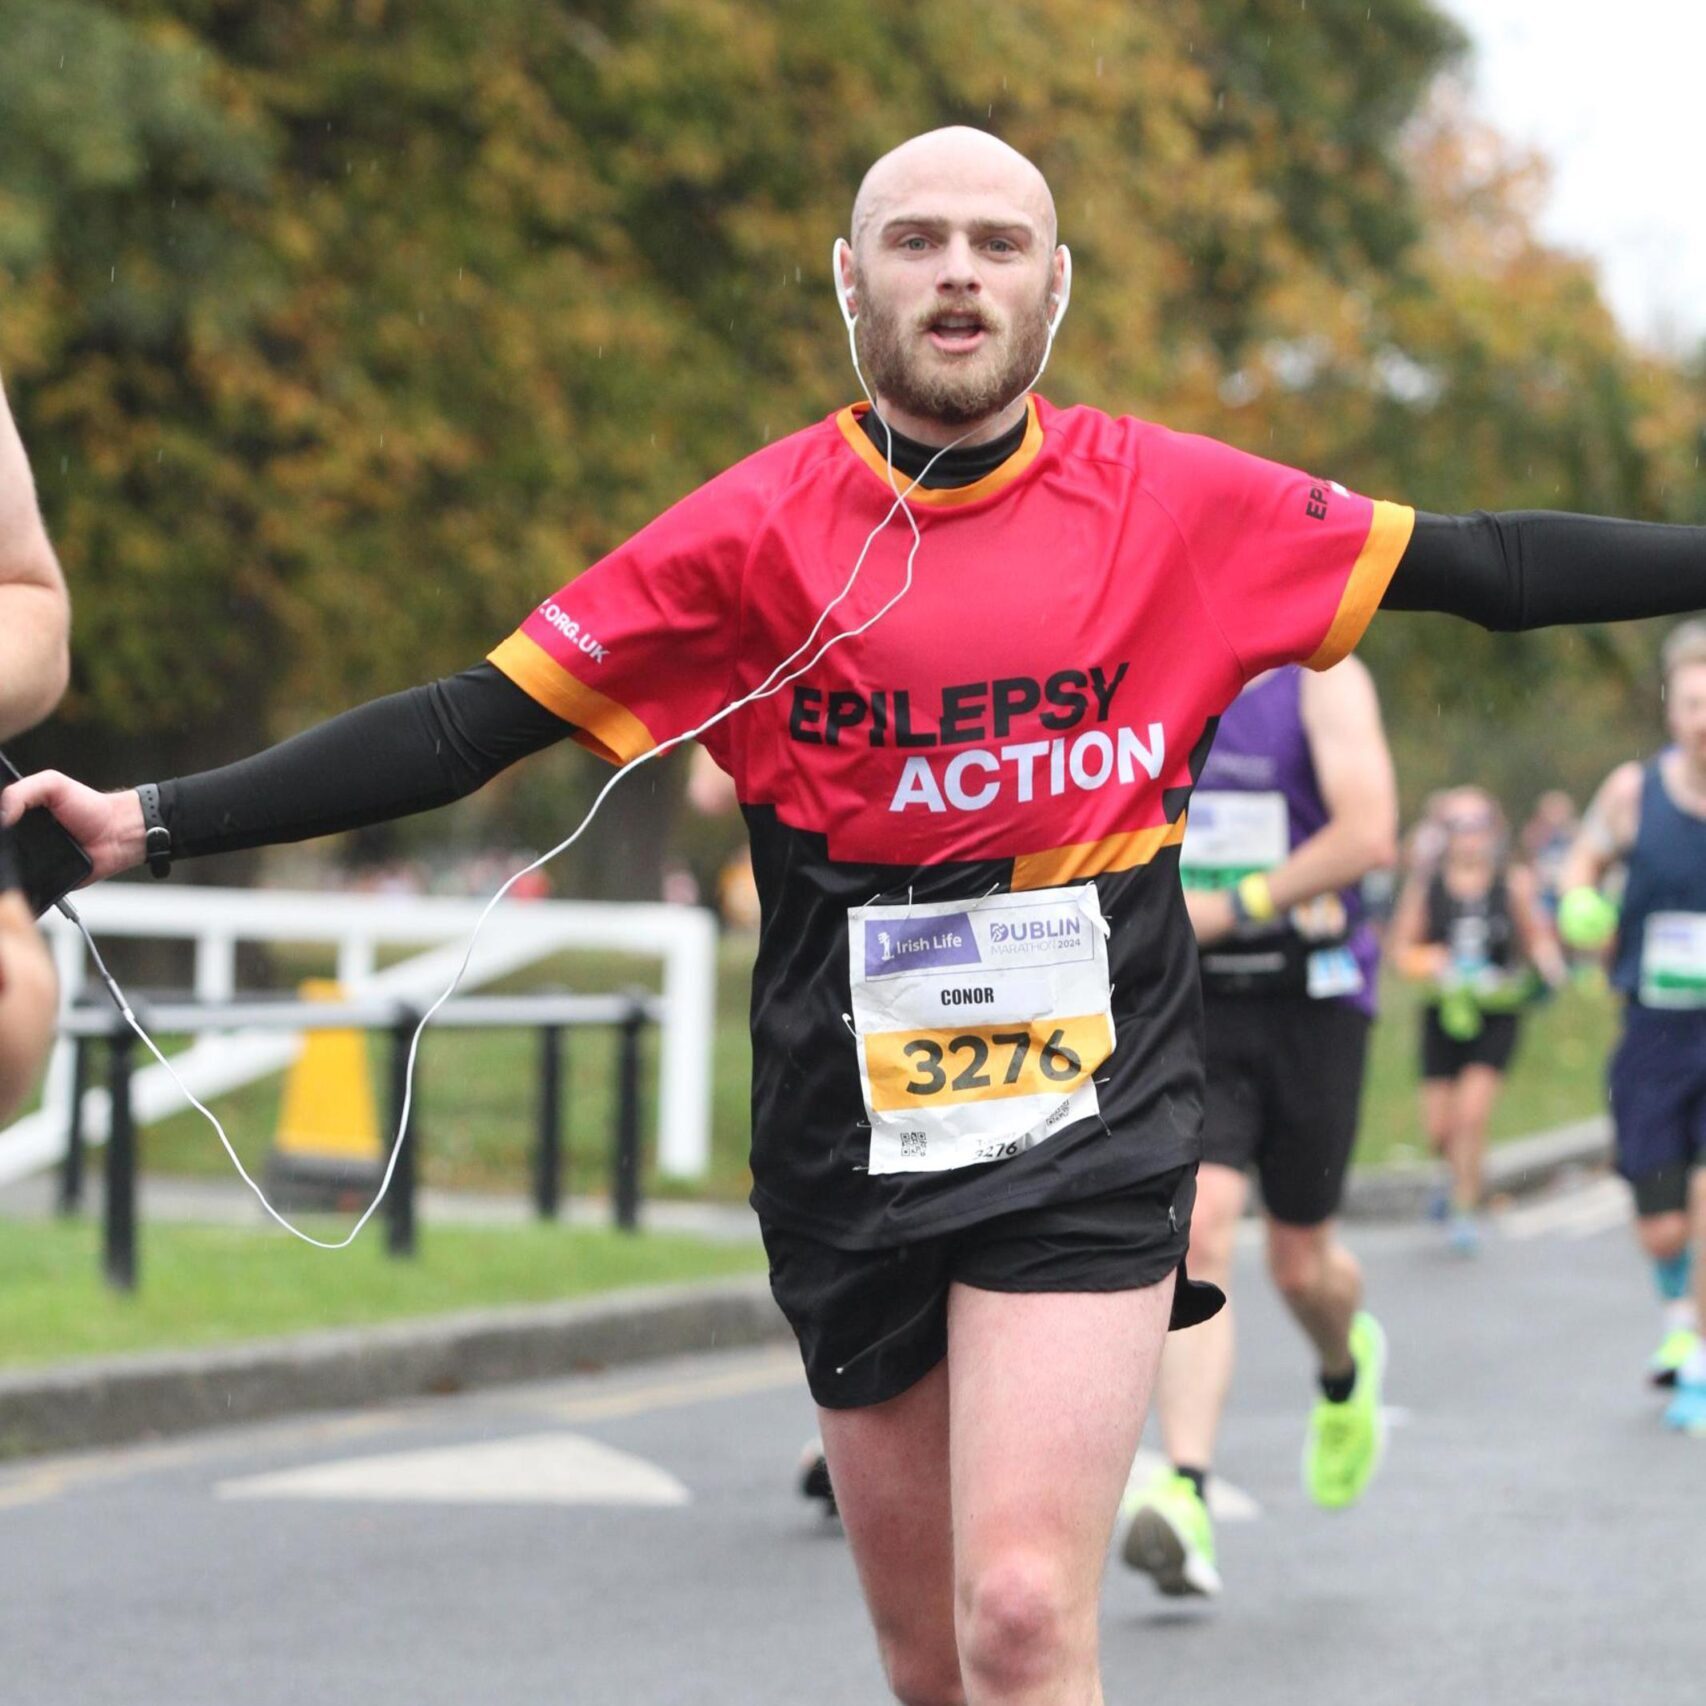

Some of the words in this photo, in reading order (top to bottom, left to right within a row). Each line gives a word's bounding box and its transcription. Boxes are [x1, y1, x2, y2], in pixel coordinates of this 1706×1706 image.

[789, 662, 1130, 748] EPILEPSY
[889, 722, 1165, 813] ACTION
[990, 916, 1080, 943] DUBLIN
[896, 937, 930, 955] Irish
[932, 932, 962, 949] Life
[1057, 938, 1081, 949] 2024
[940, 987, 995, 1006] CONOR
[903, 1029, 1082, 1096] 3276
